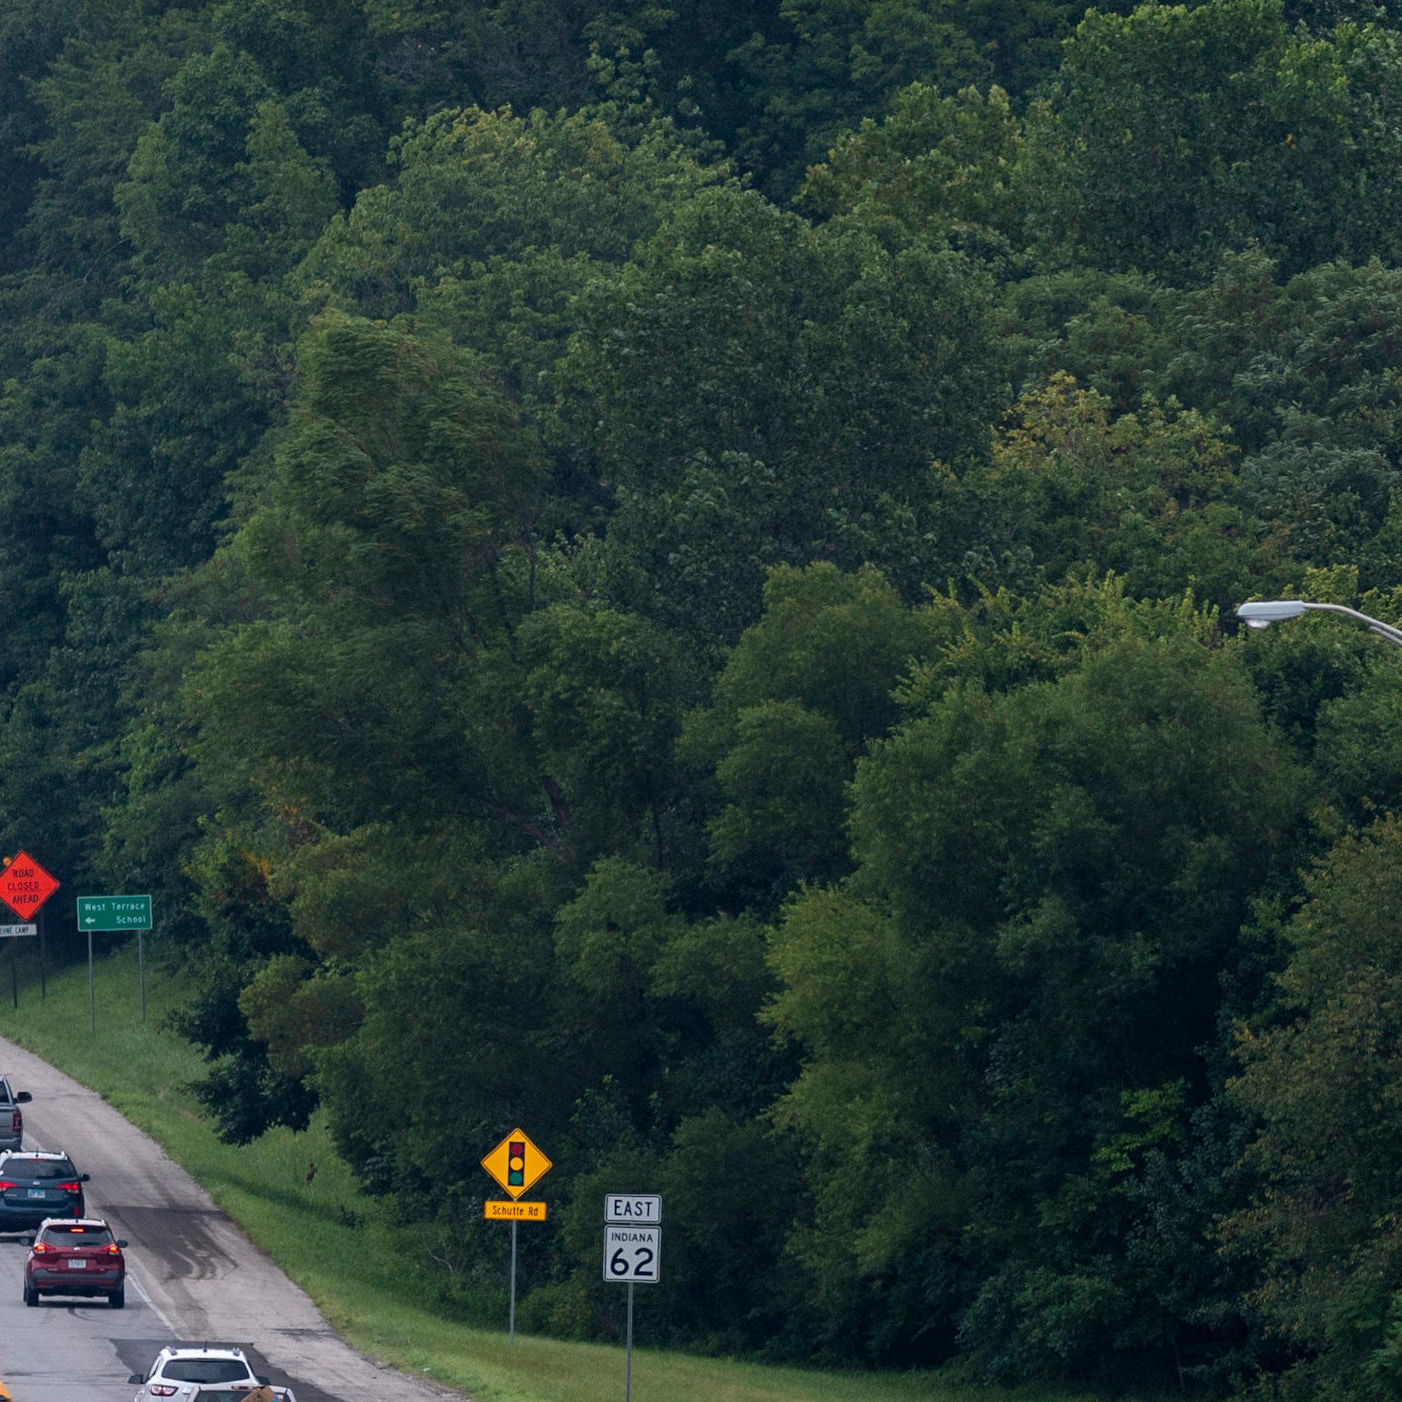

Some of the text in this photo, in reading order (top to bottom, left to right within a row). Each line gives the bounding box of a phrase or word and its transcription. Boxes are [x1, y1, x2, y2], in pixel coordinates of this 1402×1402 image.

[12, 868, 34, 878] ROAD
[7, 881, 39, 891] CLOSED
[12, 894, 39, 904] AHEAD
[84, 902, 145, 911] West Terrace
[116, 915, 146, 924] School
[15, 926, 29, 934] CAMP
[492, 1205, 539, 1217] Schutte Rd
[614, 1199, 653, 1217] EAST
[611, 1232, 653, 1243] INDIANA
[610, 1247, 654, 1276] 62
